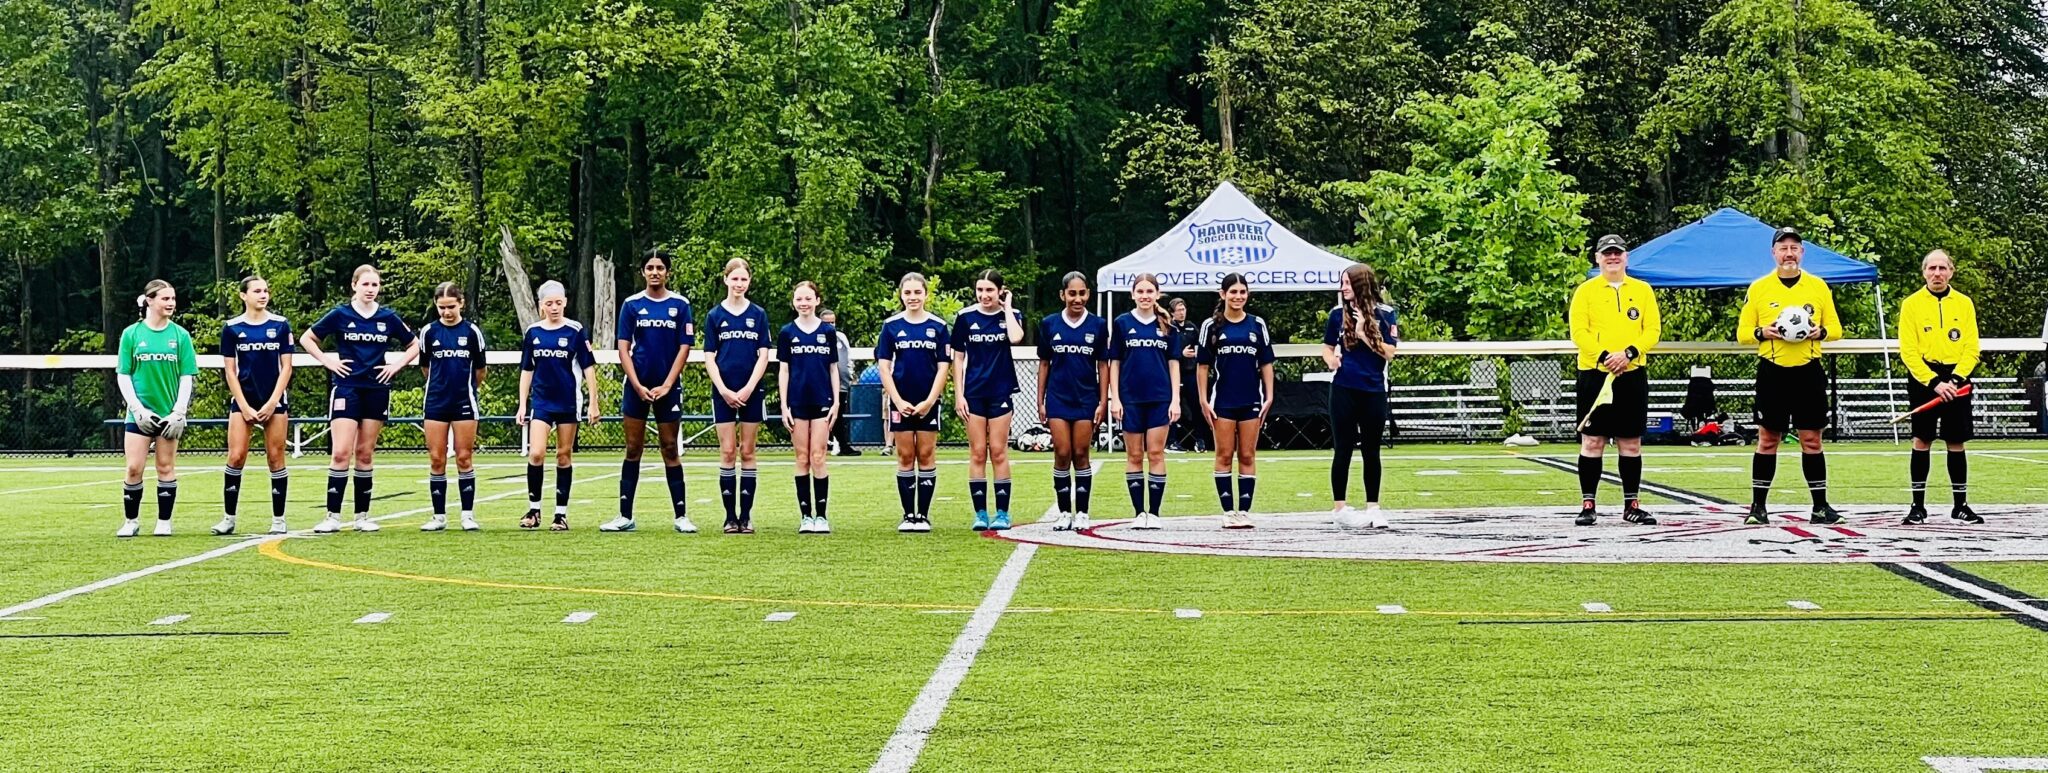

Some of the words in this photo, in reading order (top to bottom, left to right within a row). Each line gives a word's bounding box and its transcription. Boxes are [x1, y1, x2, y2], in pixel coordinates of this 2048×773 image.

[1197, 223, 1263, 238] HANOVER
[1198, 233, 1236, 244] SOCCER
[1239, 233, 1264, 241] CLUB
[1113, 271, 1209, 285] HAOVER
[1215, 271, 1298, 285] SCCER
[1303, 271, 1341, 284] CLU
